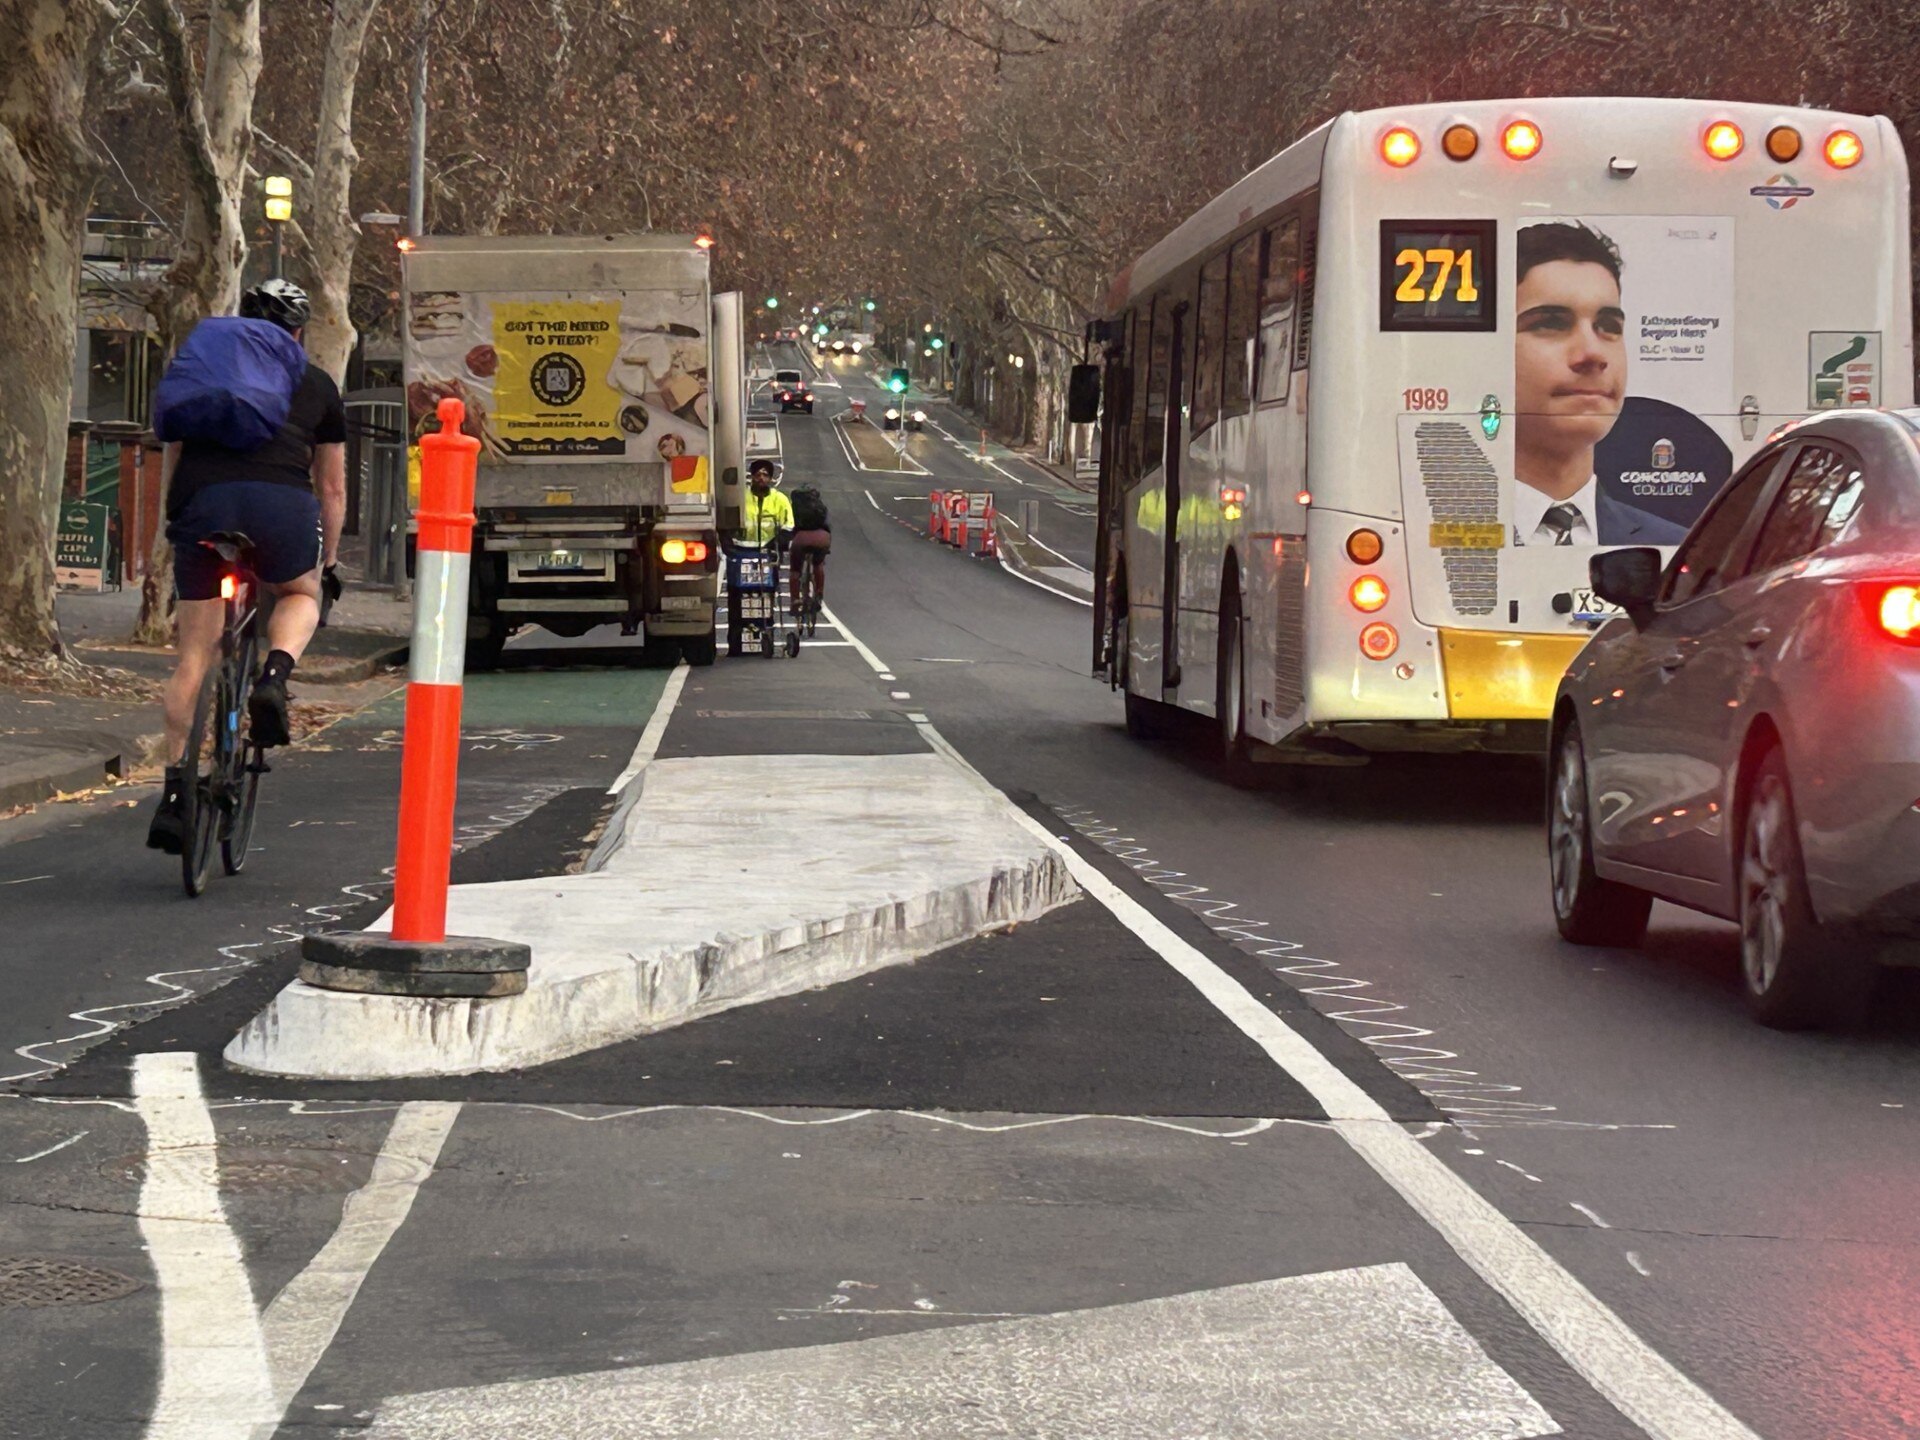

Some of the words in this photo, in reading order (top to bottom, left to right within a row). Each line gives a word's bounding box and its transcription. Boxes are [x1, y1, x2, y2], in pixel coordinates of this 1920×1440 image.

[1395, 249, 1478, 302] 271
[569, 321, 610, 332] NEED
[1402, 387, 1449, 411] 1989
[1620, 471, 1707, 483] CONCORDIA
[1632, 484, 1693, 495] COLLEGE
